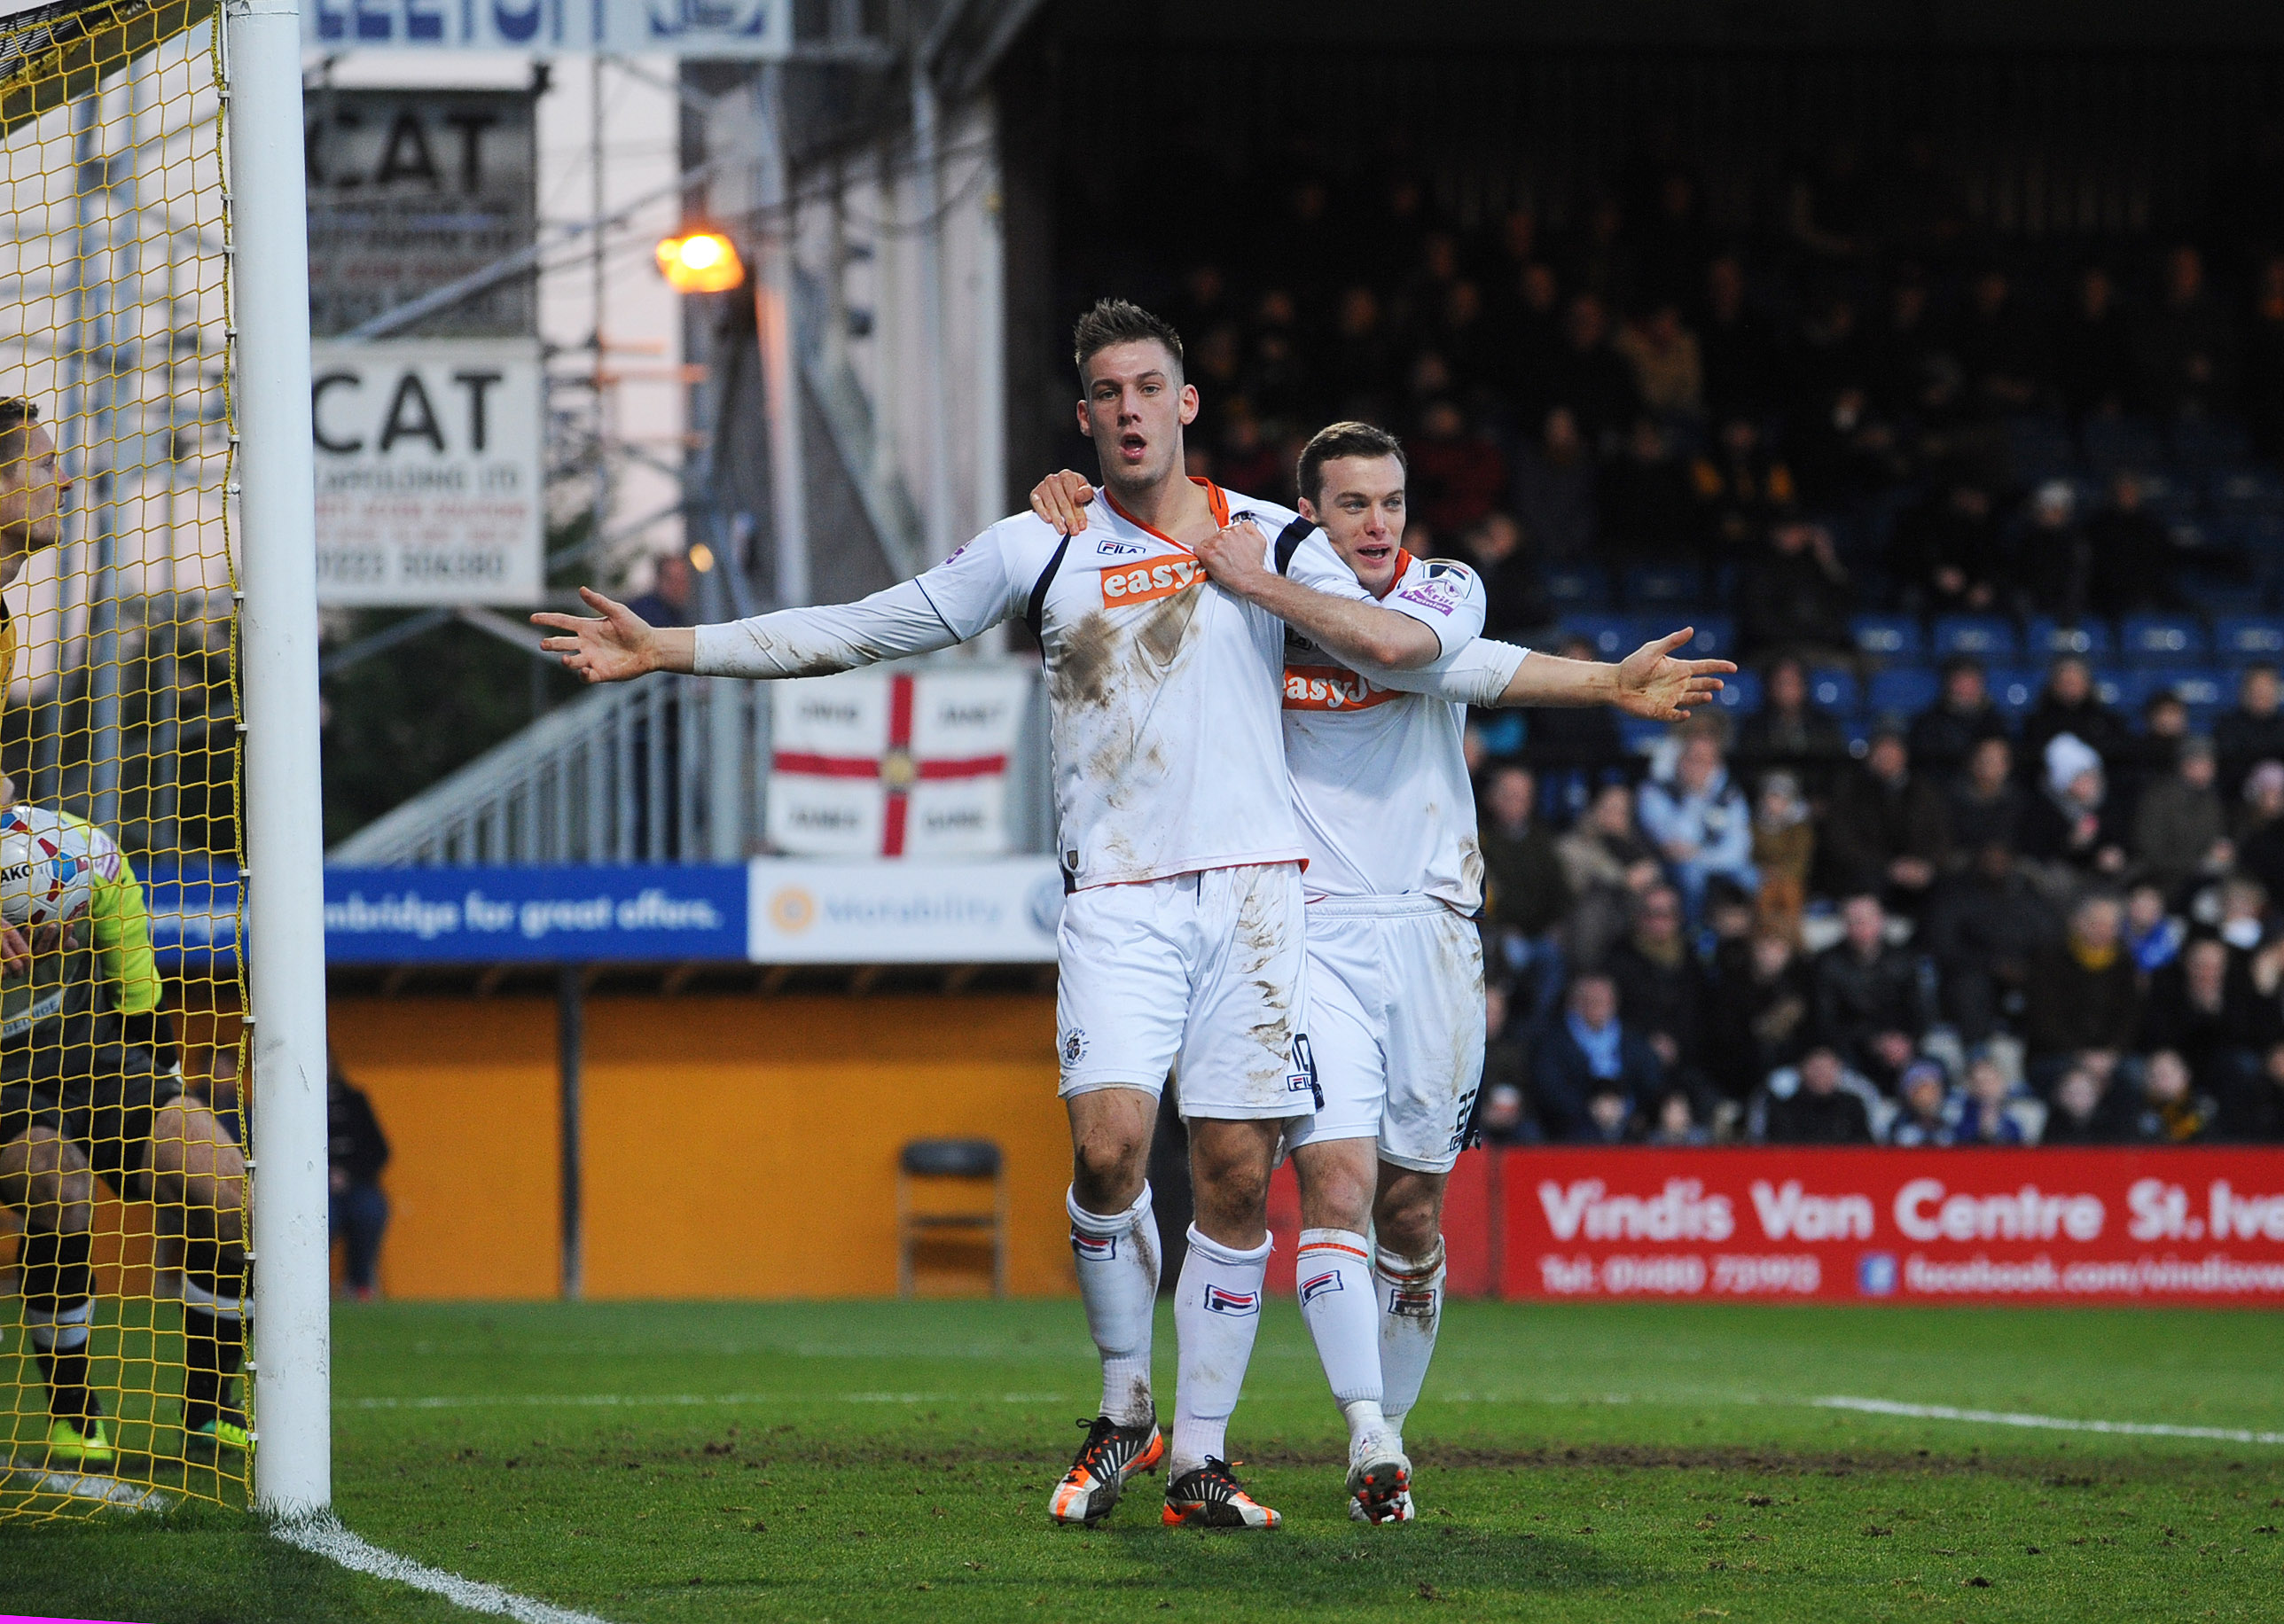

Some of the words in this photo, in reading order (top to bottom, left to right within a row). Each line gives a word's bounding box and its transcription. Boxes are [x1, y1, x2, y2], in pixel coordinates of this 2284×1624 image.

[312, 371, 502, 452] CAT
[1102, 543, 1137, 554] FILA
[1104, 559, 1207, 597] easy
[1283, 674, 1388, 708] asyJ
[465, 890, 514, 931] for
[520, 896, 612, 938] great
[1538, 1178, 1735, 1241] Vindis
[1750, 1179, 1874, 1241] Van
[1893, 1177, 2105, 1241] Centre
[2129, 1177, 2204, 1241] St.
